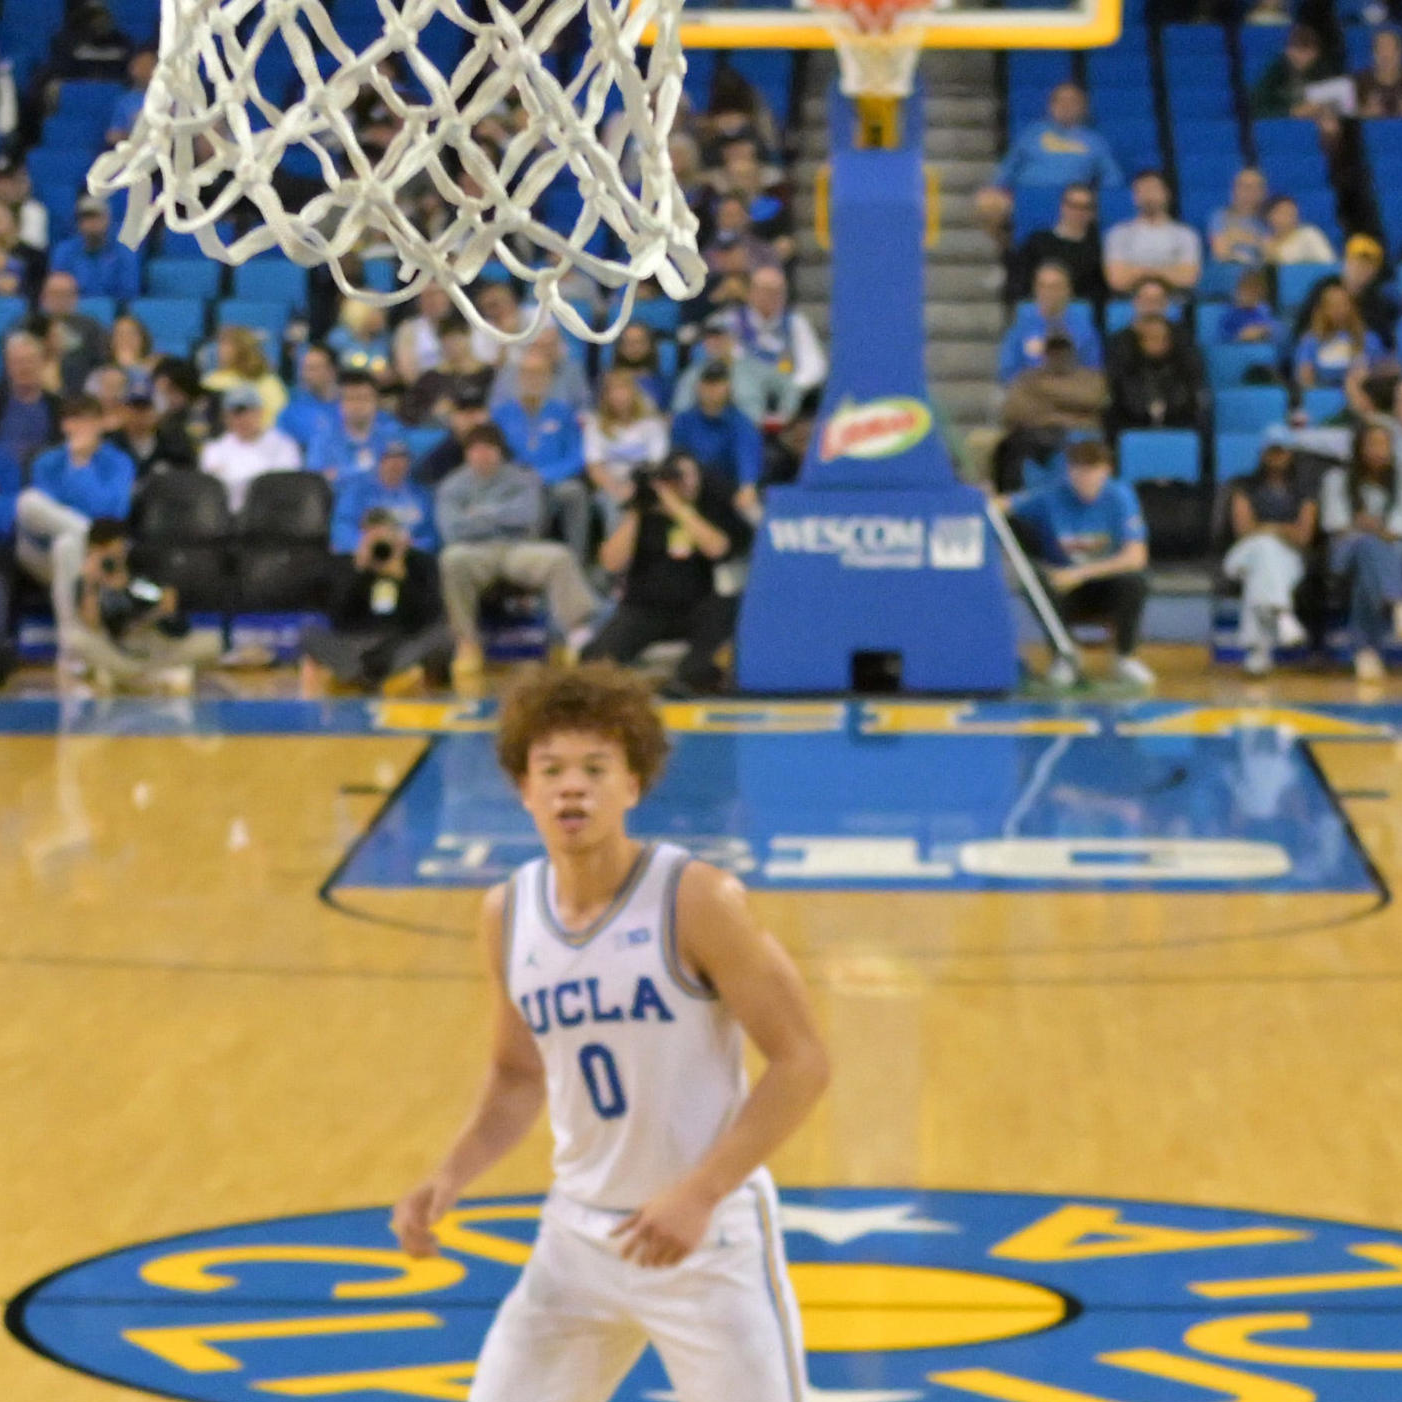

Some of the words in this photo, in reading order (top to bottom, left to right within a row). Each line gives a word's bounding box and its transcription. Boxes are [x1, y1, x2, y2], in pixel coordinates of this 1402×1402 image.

[768, 516, 926, 554] WESCOM
[520, 975, 676, 1035] UCLA
[578, 1042, 627, 1121] 0
